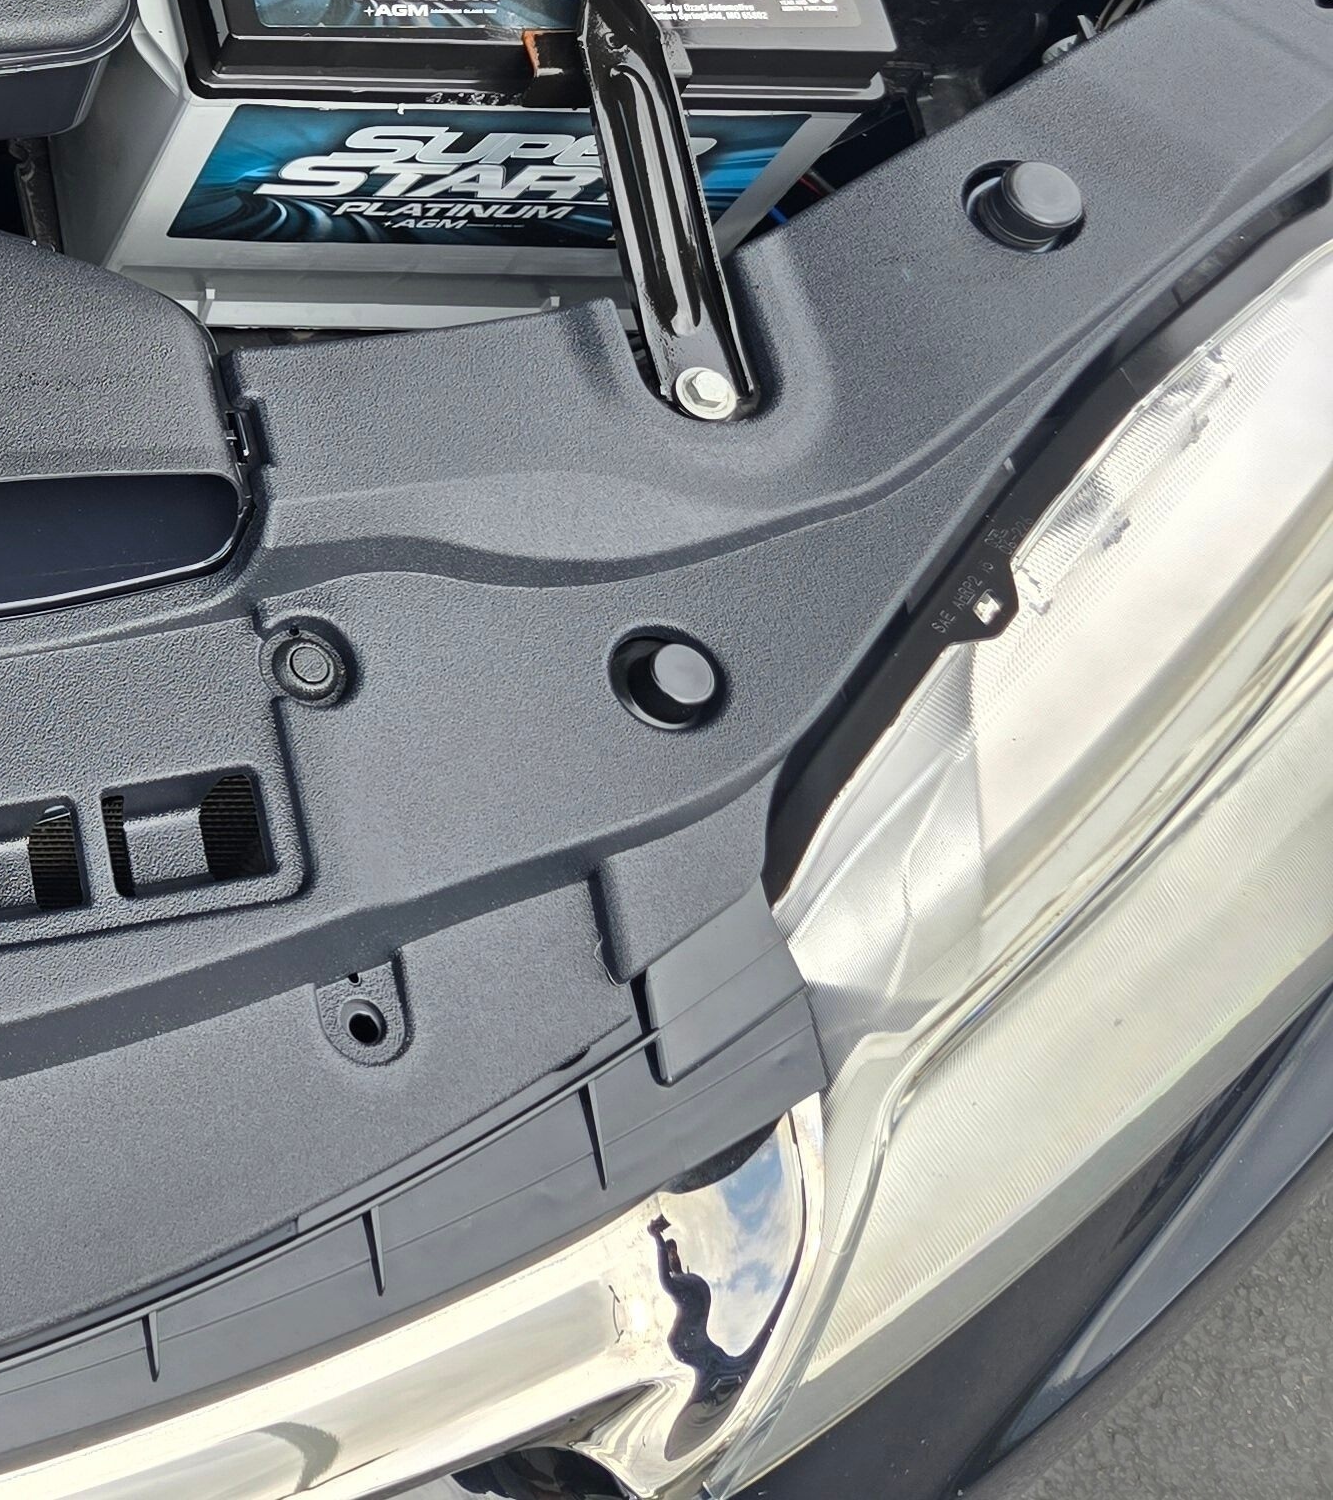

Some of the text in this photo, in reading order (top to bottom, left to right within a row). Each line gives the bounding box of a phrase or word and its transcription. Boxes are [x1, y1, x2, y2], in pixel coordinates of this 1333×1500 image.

[374, 4, 429, 17] AGM
[346, 126, 717, 165] SUPE
[253, 152, 608, 200] STAR
[333, 201, 573, 220] PLATINUM
[391, 219, 469, 229] AGM
